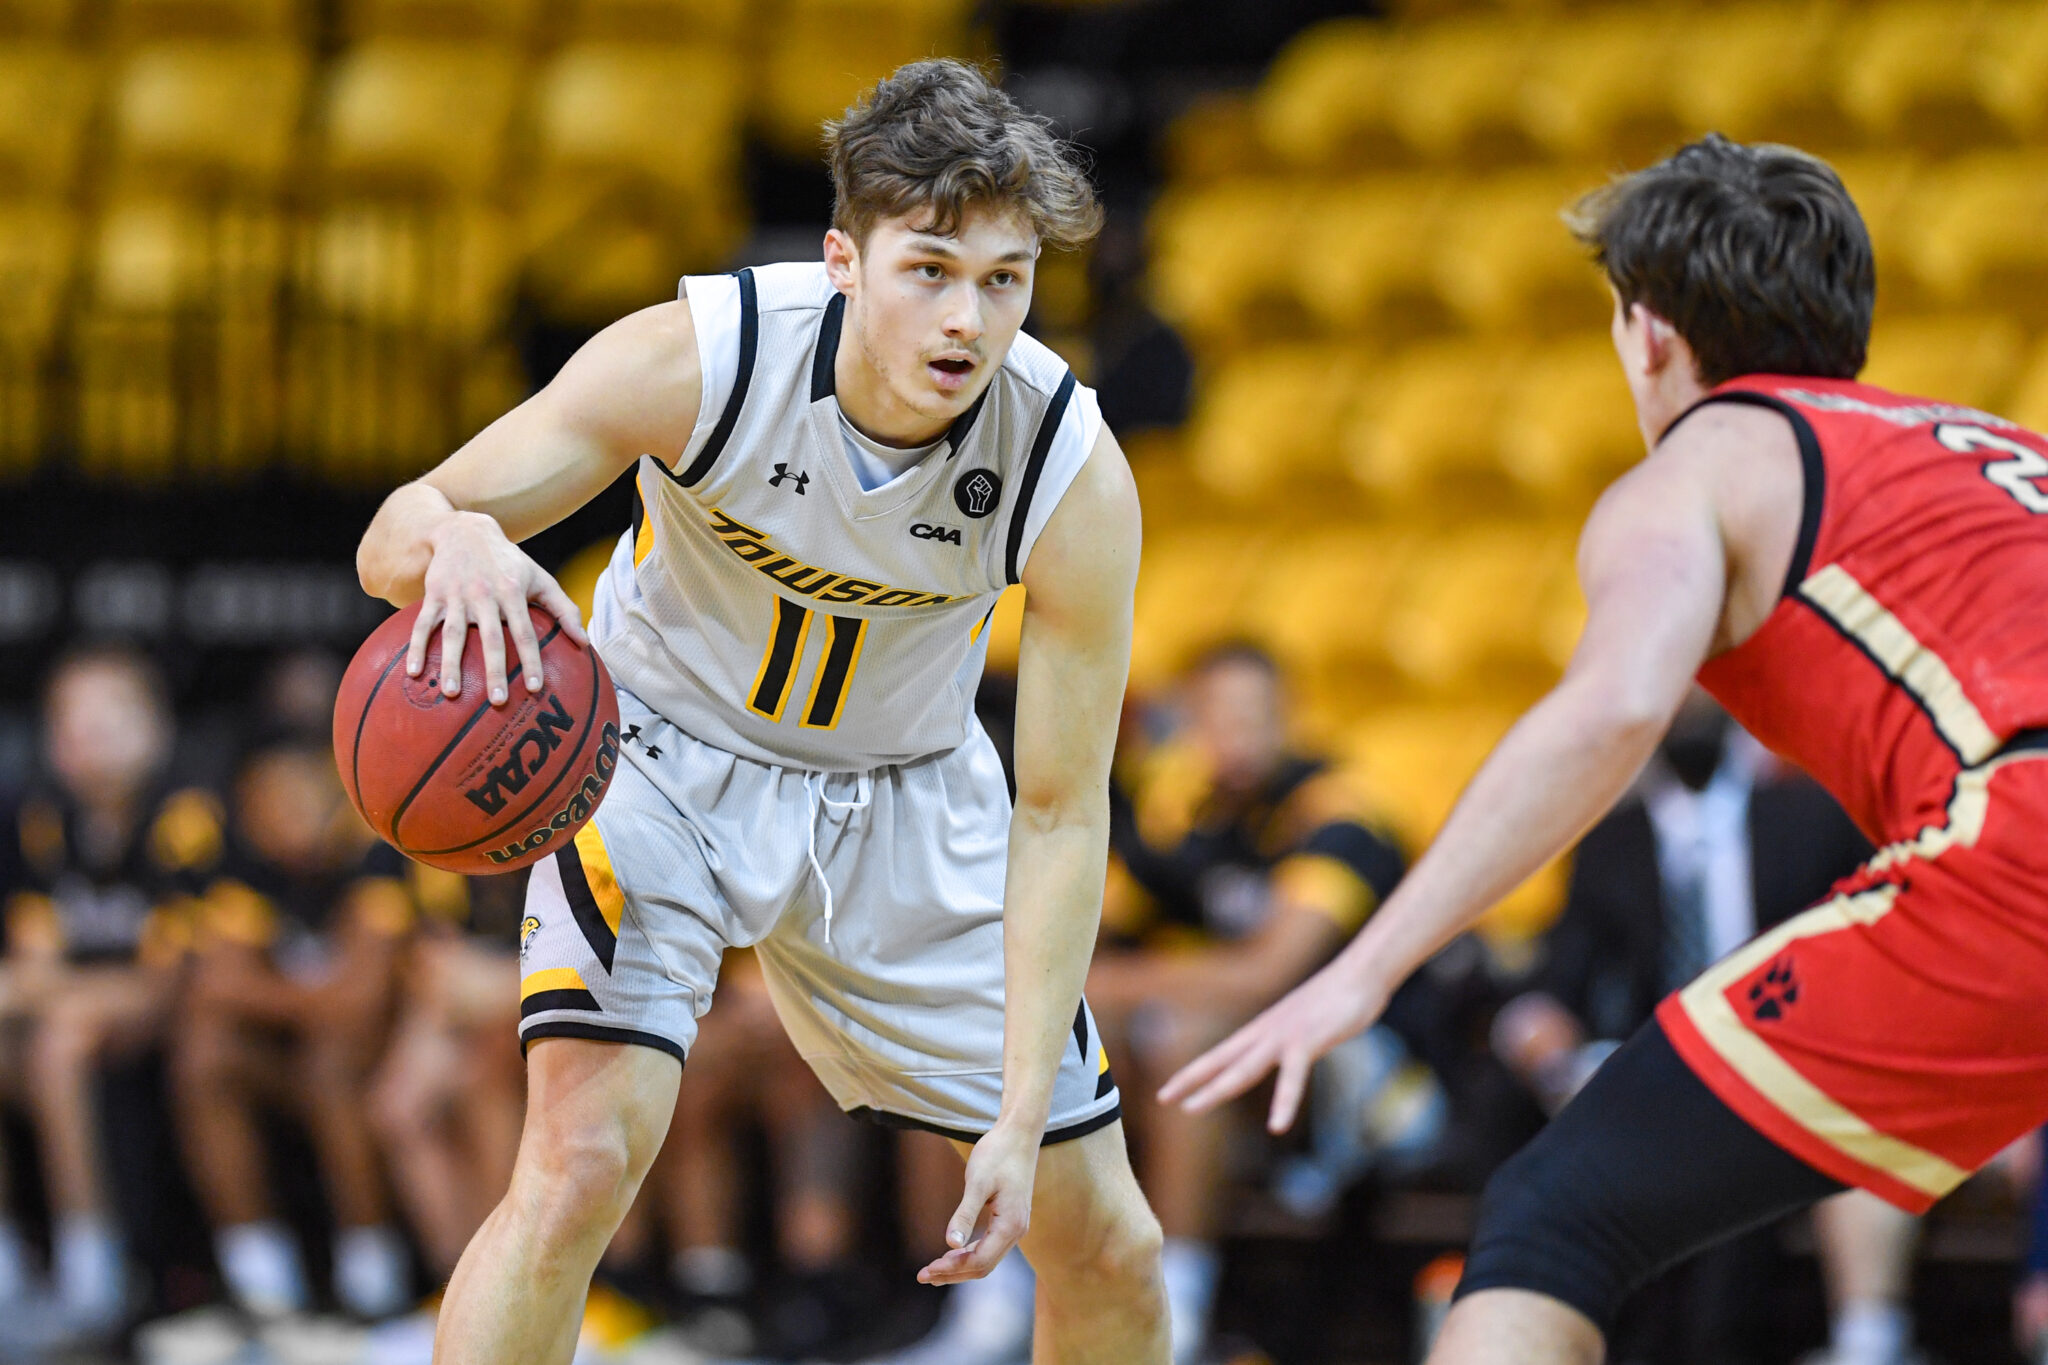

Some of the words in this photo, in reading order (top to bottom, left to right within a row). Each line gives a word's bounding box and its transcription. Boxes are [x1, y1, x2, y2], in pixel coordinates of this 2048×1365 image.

[909, 523, 962, 547] CAA
[745, 593, 869, 730] 11
[465, 693, 575, 816] NCAA
[483, 720, 620, 864] Wilson
